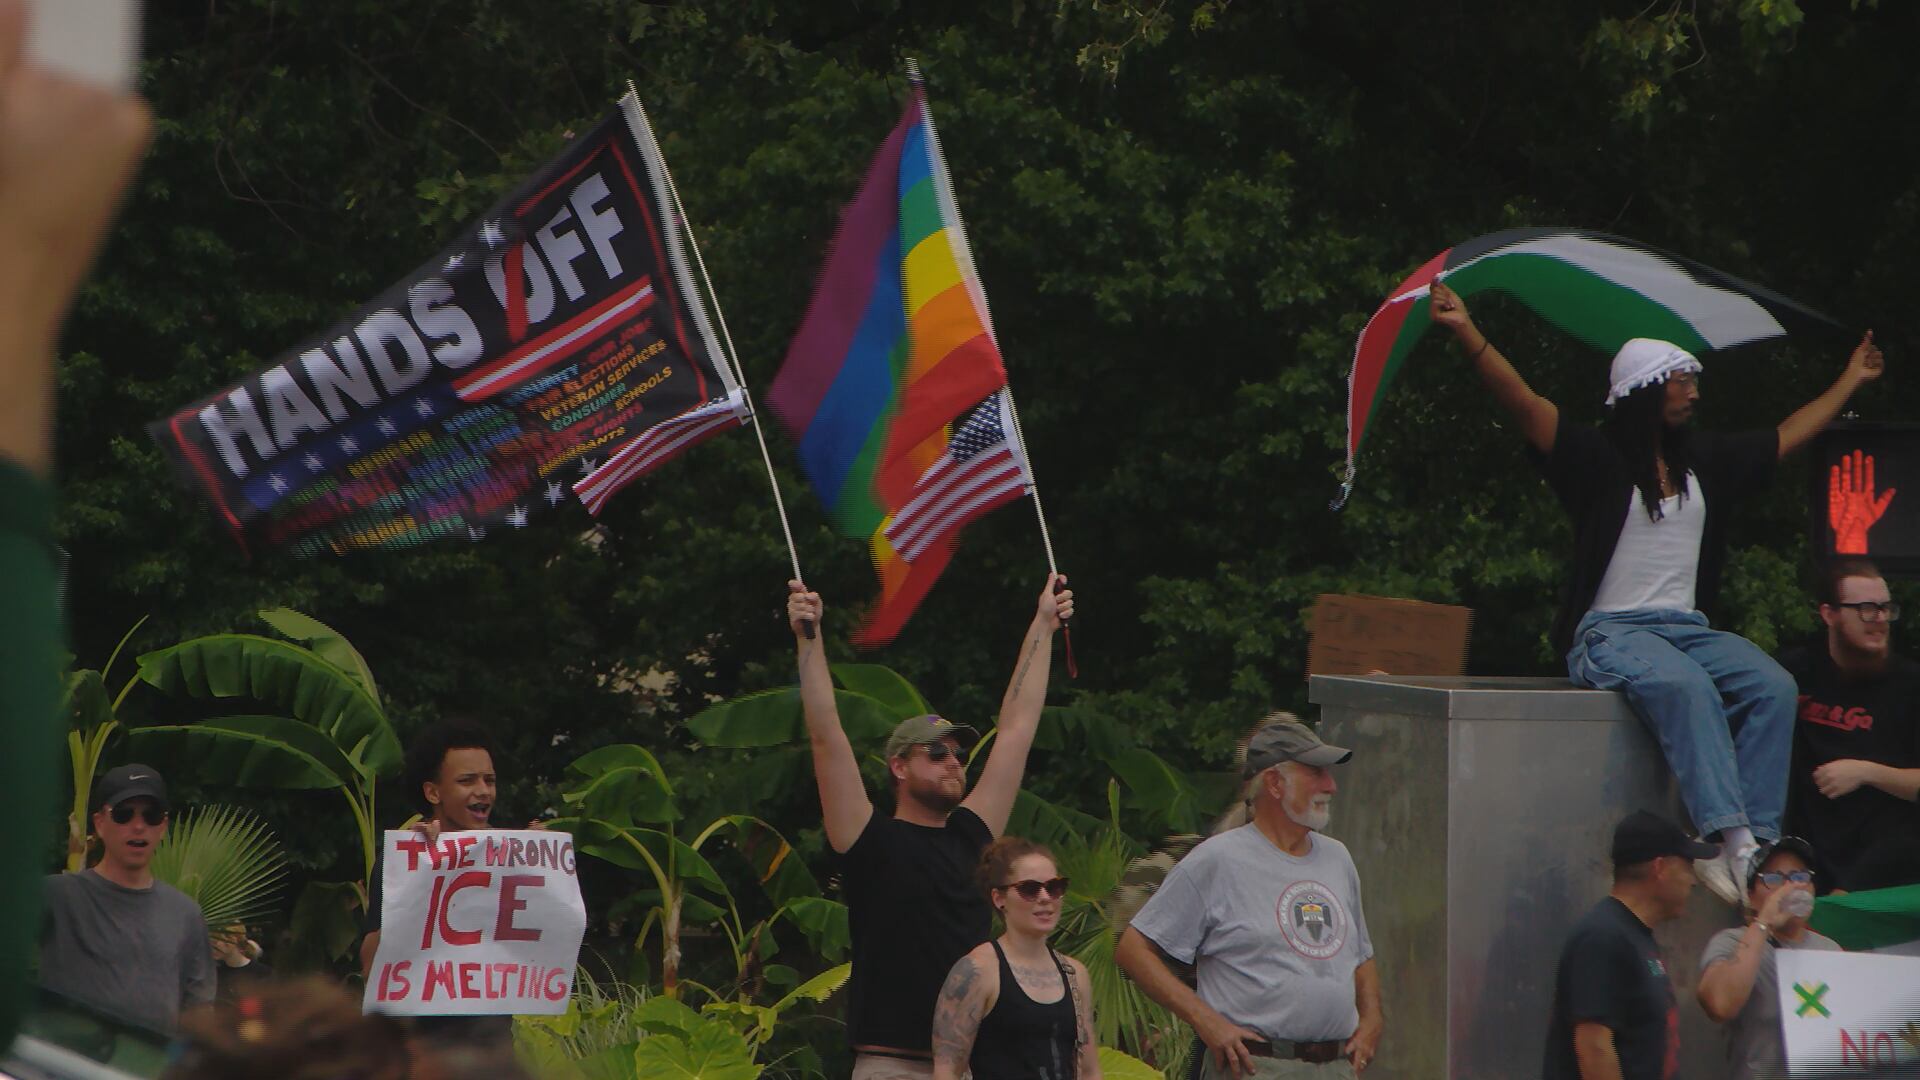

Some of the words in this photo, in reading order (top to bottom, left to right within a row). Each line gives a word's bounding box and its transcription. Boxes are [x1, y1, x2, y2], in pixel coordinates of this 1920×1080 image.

[199, 277, 485, 479] HANDS
[483, 171, 624, 327] OFF
[540, 382, 606, 421] VETERAN
[607, 338, 668, 385] SERVICES
[564, 343, 636, 392] ELECTIONS
[615, 366, 673, 412] SCHOOLS
[551, 381, 627, 431] CONSUMER
[396, 837, 478, 871] THE
[485, 836, 577, 875] WRONG
[421, 872, 545, 950] ICE
[377, 960, 412, 1001] IS
[421, 960, 568, 1001] MELTING
